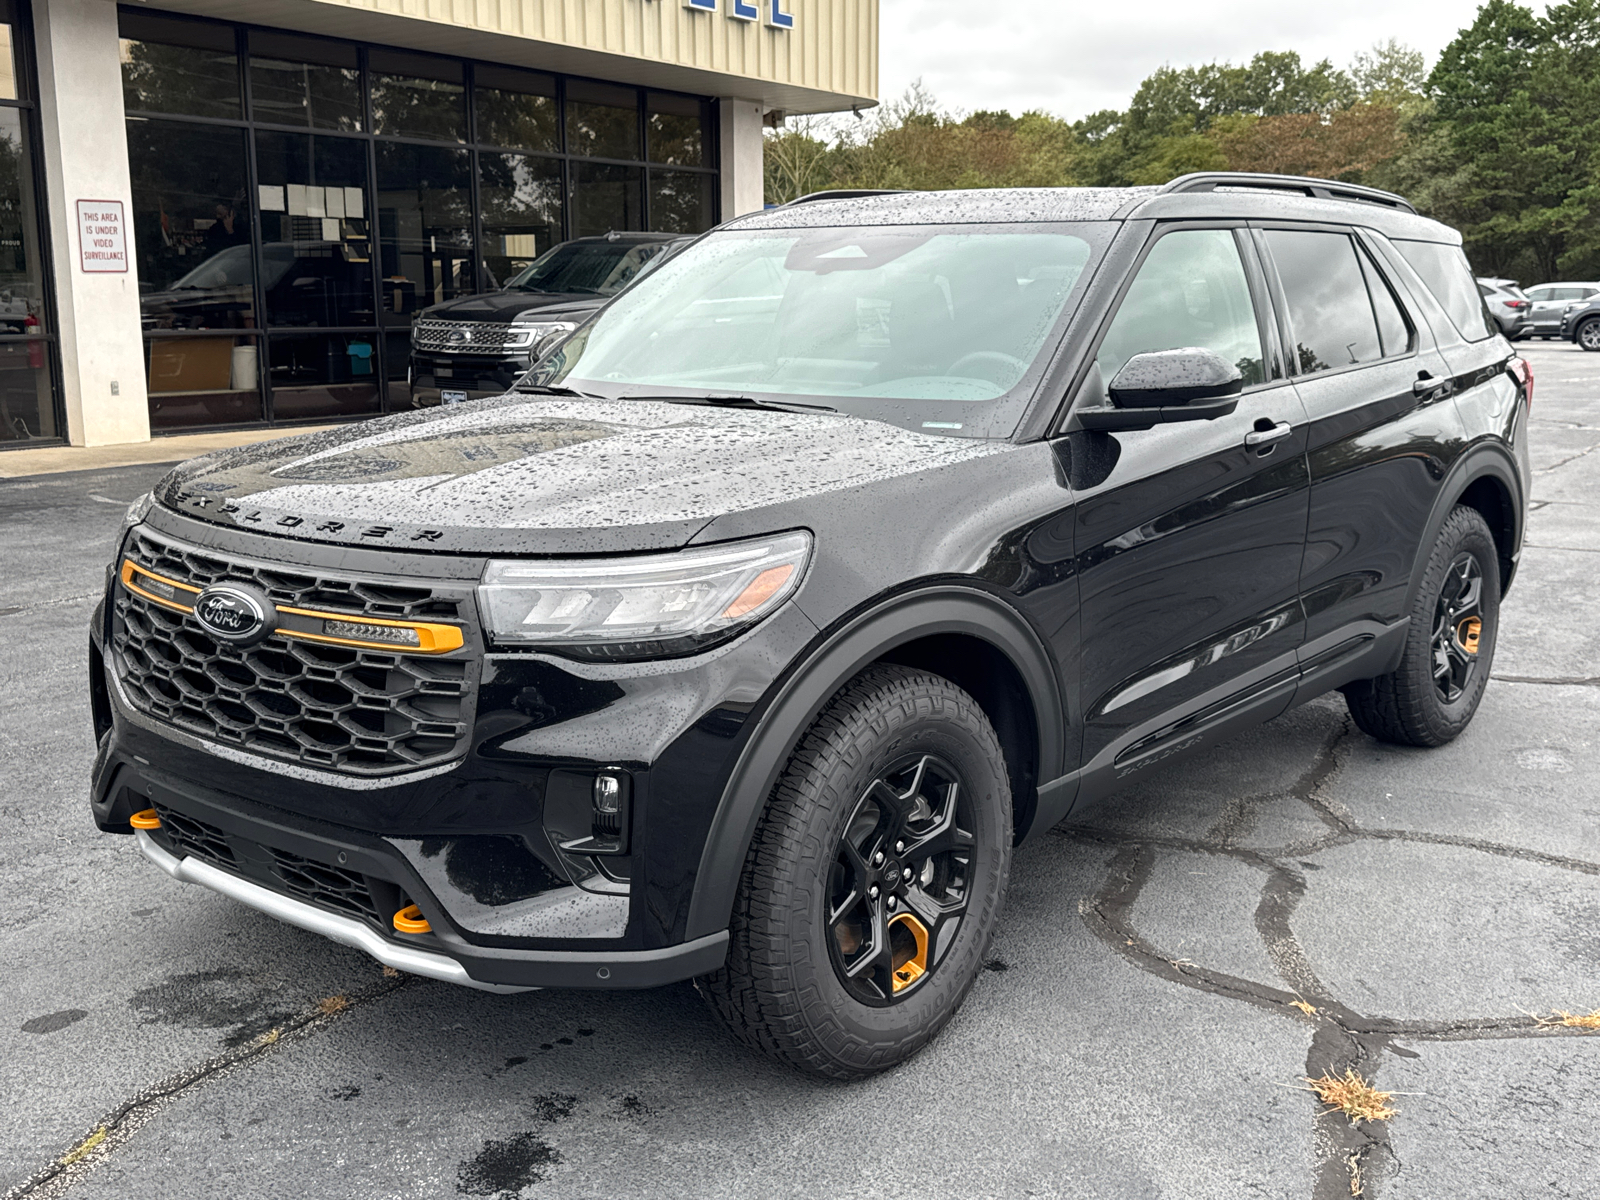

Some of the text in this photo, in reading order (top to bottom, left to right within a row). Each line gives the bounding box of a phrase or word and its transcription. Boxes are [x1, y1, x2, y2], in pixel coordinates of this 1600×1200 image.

[83, 212, 119, 222] THIS AREA
[86, 225, 118, 235] IS UNDER
[93, 238, 114, 248] VIDEO
[84, 251, 124, 260] SURVEILLANCE
[174, 491, 444, 541] EXPLORER
[907, 846, 1001, 1033] BRIDGESTONE
